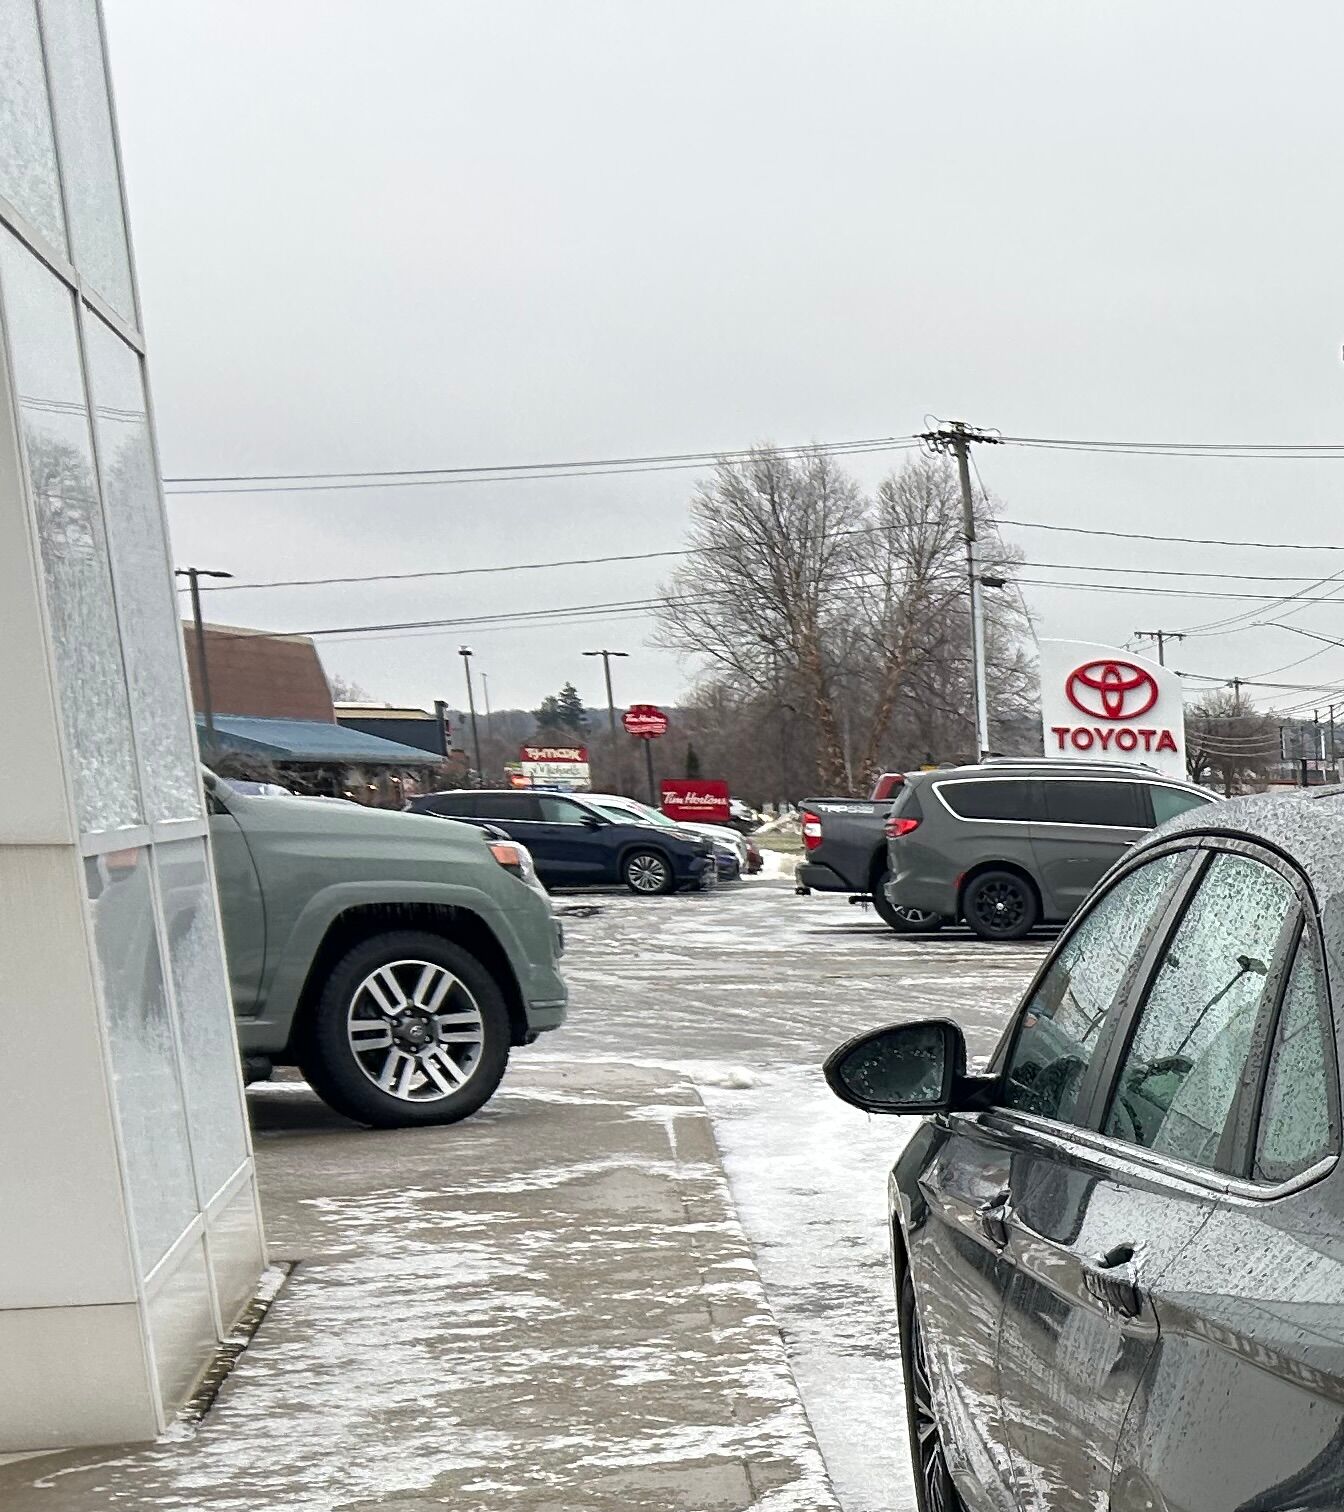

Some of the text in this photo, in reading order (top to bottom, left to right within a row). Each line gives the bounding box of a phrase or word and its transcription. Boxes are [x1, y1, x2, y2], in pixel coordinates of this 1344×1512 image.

[1051, 727, 1178, 752] TOYOTA
[662, 791, 728, 805] Tim Hortons
